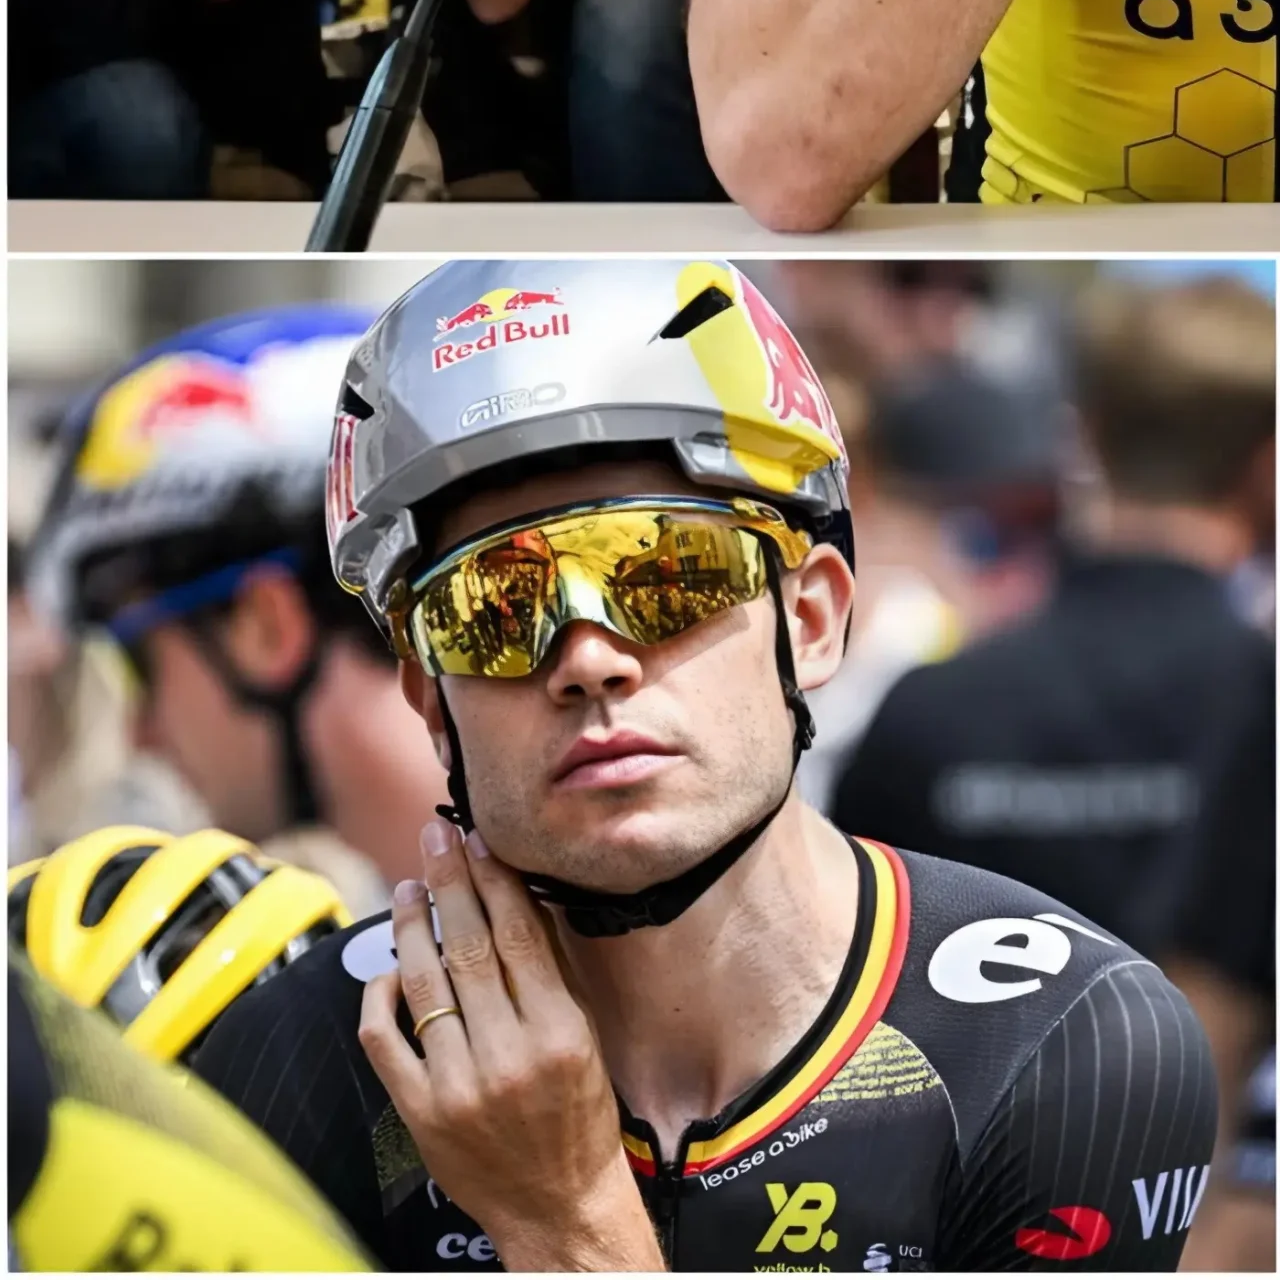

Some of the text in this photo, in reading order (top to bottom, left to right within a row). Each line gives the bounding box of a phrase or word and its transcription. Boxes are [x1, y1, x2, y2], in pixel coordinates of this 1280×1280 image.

[433, 312, 571, 371] Red Bull
[699, 1149, 766, 1191] lease
